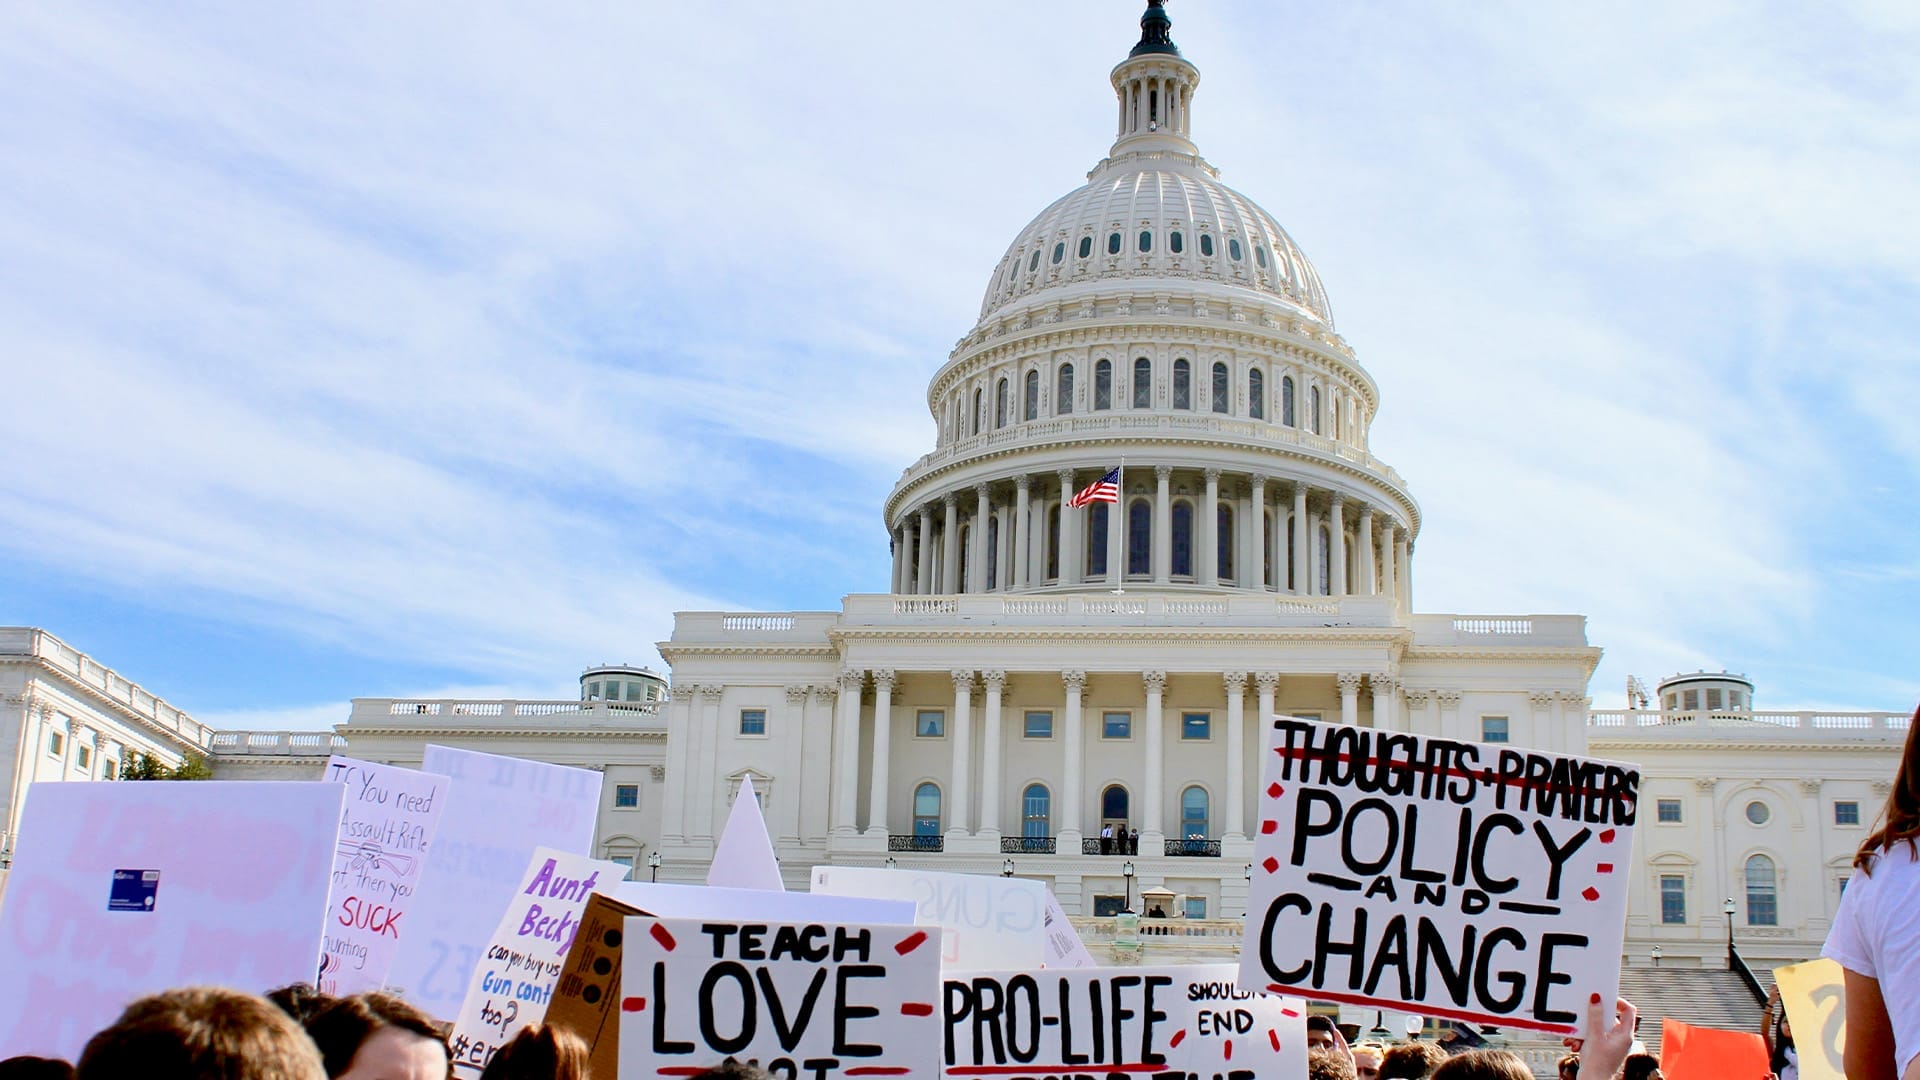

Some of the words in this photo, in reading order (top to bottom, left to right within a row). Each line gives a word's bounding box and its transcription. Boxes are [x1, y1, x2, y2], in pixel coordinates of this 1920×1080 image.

[360, 769, 388, 804] You
[396, 785, 436, 813] need
[1274, 720, 1479, 804] THOUGHTS
[1496, 749, 1640, 826] PRAYERS
[341, 808, 395, 845] Assault
[396, 821, 428, 853] Rifle
[1291, 788, 1592, 900] POLICY
[357, 863, 386, 892] then
[390, 882, 413, 903] you
[524, 858, 600, 902] Aunt
[1366, 875, 1490, 914] AND
[338, 896, 402, 939] SUCK
[488, 944, 508, 961] can
[508, 950, 524, 972] you
[524, 953, 544, 980] buy
[546, 961, 561, 977] us
[701, 923, 871, 962] TEACH
[1259, 893, 1588, 1023] CHANGE
[482, 970, 512, 999] Gun
[481, 1000, 518, 1038] too?
[653, 961, 886, 1057] LOVE
[944, 974, 1172, 1065] PRO-LIFE
[1198, 1009, 1254, 1036] END
